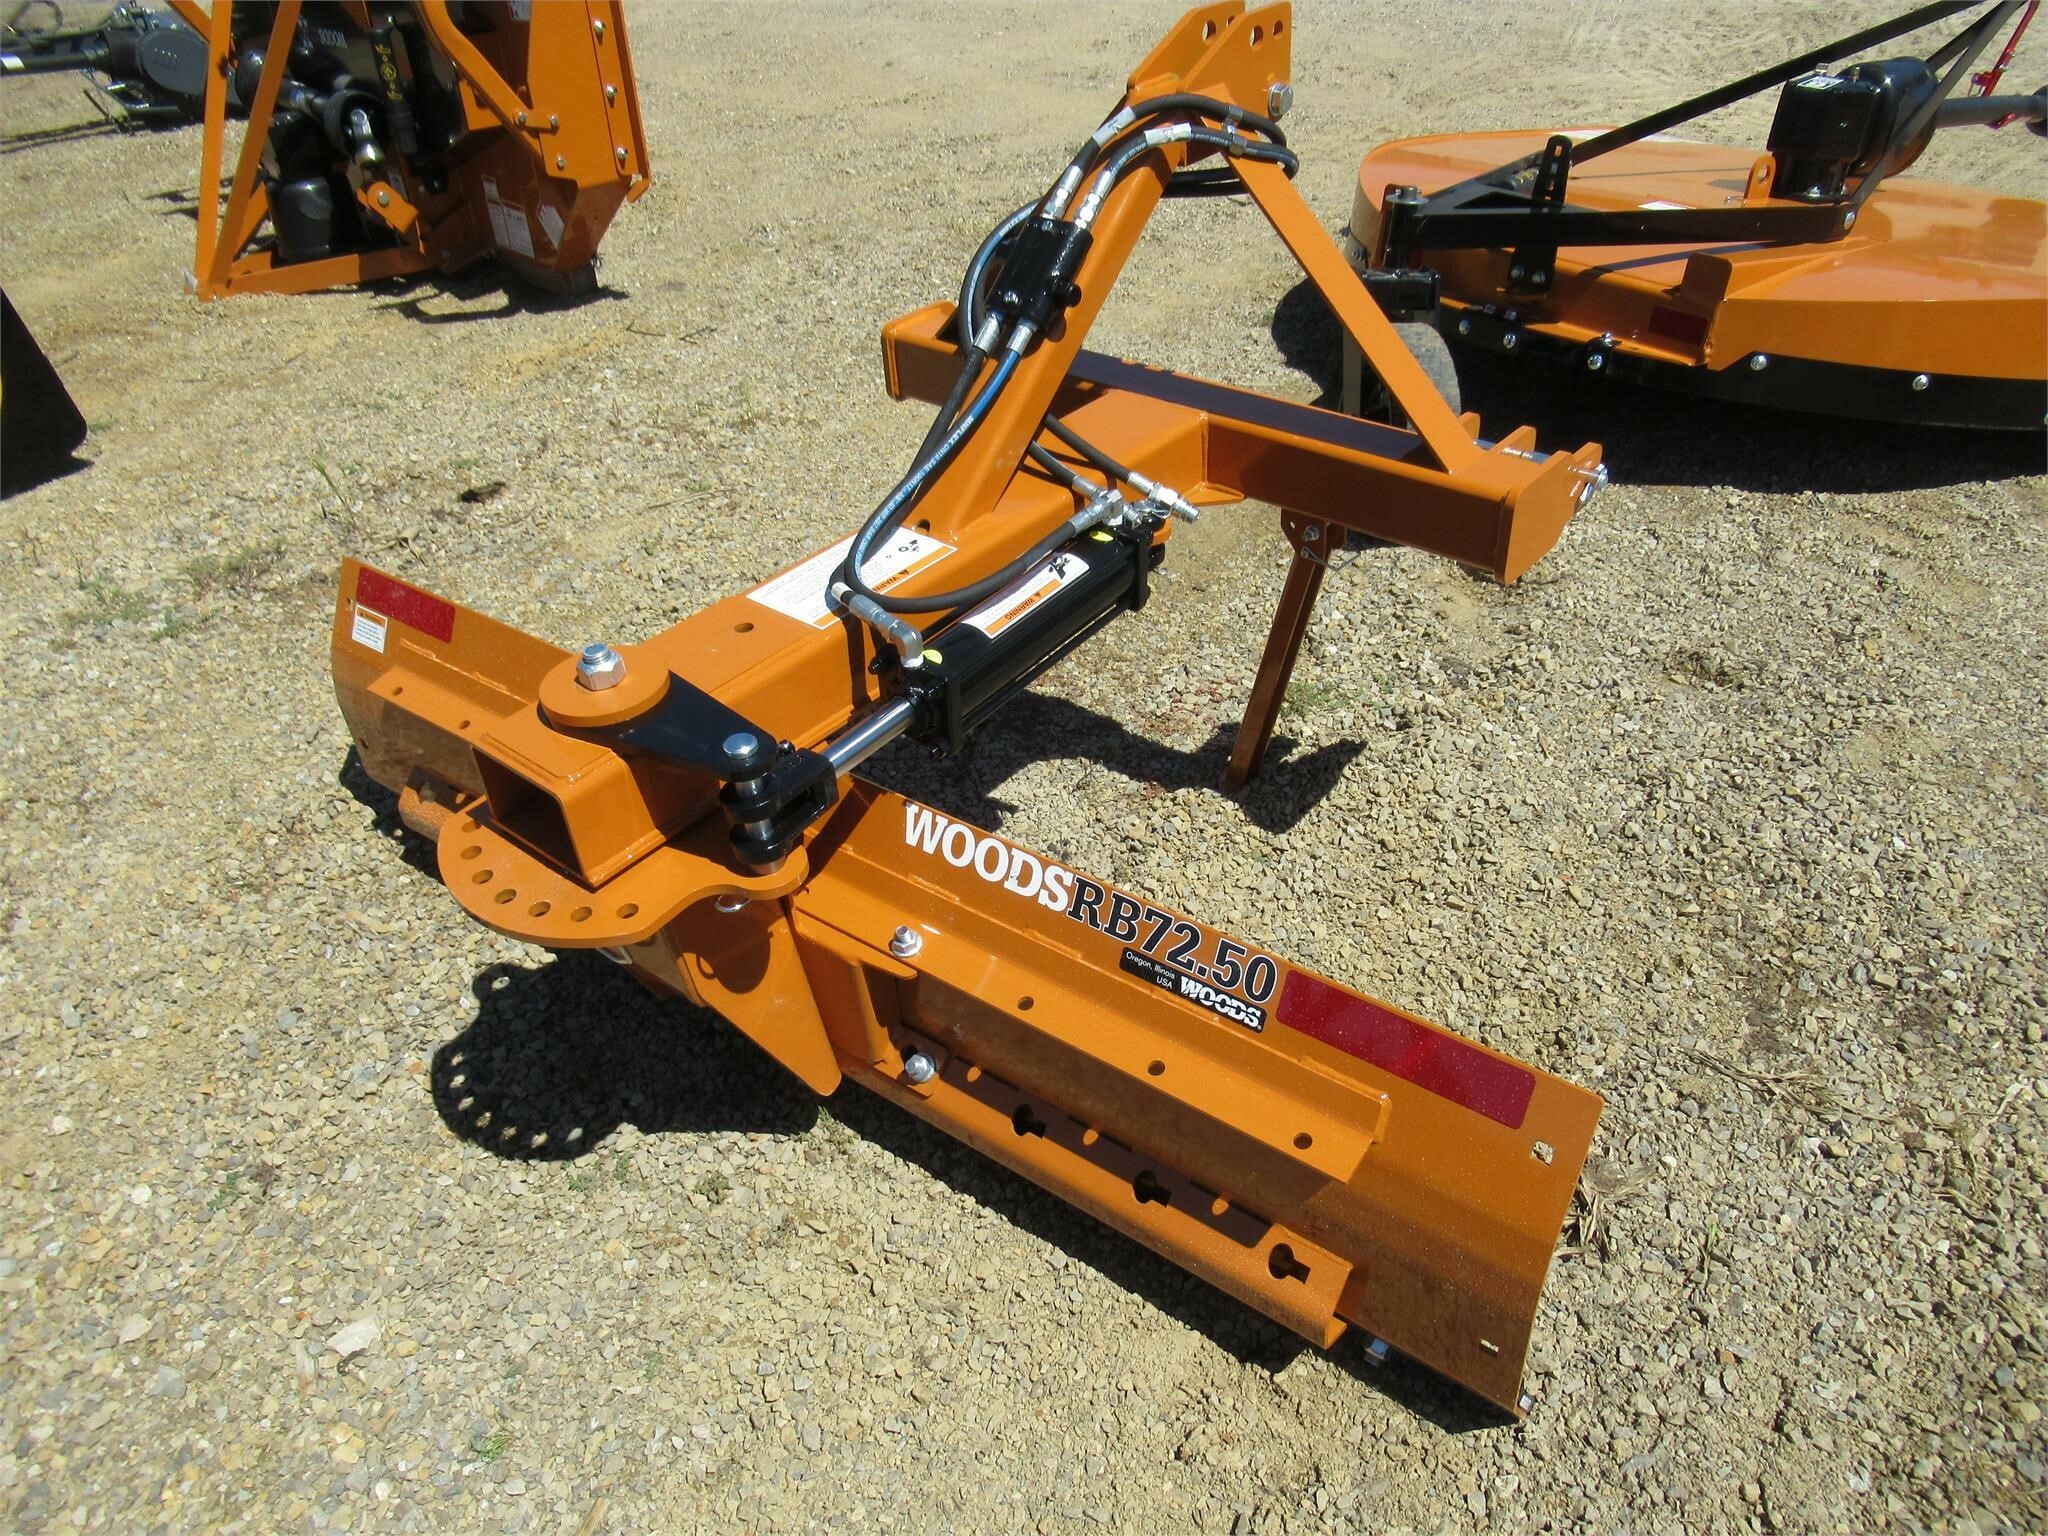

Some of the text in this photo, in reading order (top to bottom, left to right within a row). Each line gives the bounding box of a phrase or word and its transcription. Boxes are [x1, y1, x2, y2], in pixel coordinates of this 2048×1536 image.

[1004, 597, 1036, 620] WARNING
[904, 801, 1277, 1004] WOODS RB72.50
[1125, 950, 1176, 980] Oregon, Illinois
[1156, 975, 1173, 990] USA
[1179, 974, 1262, 1029] WOODS
